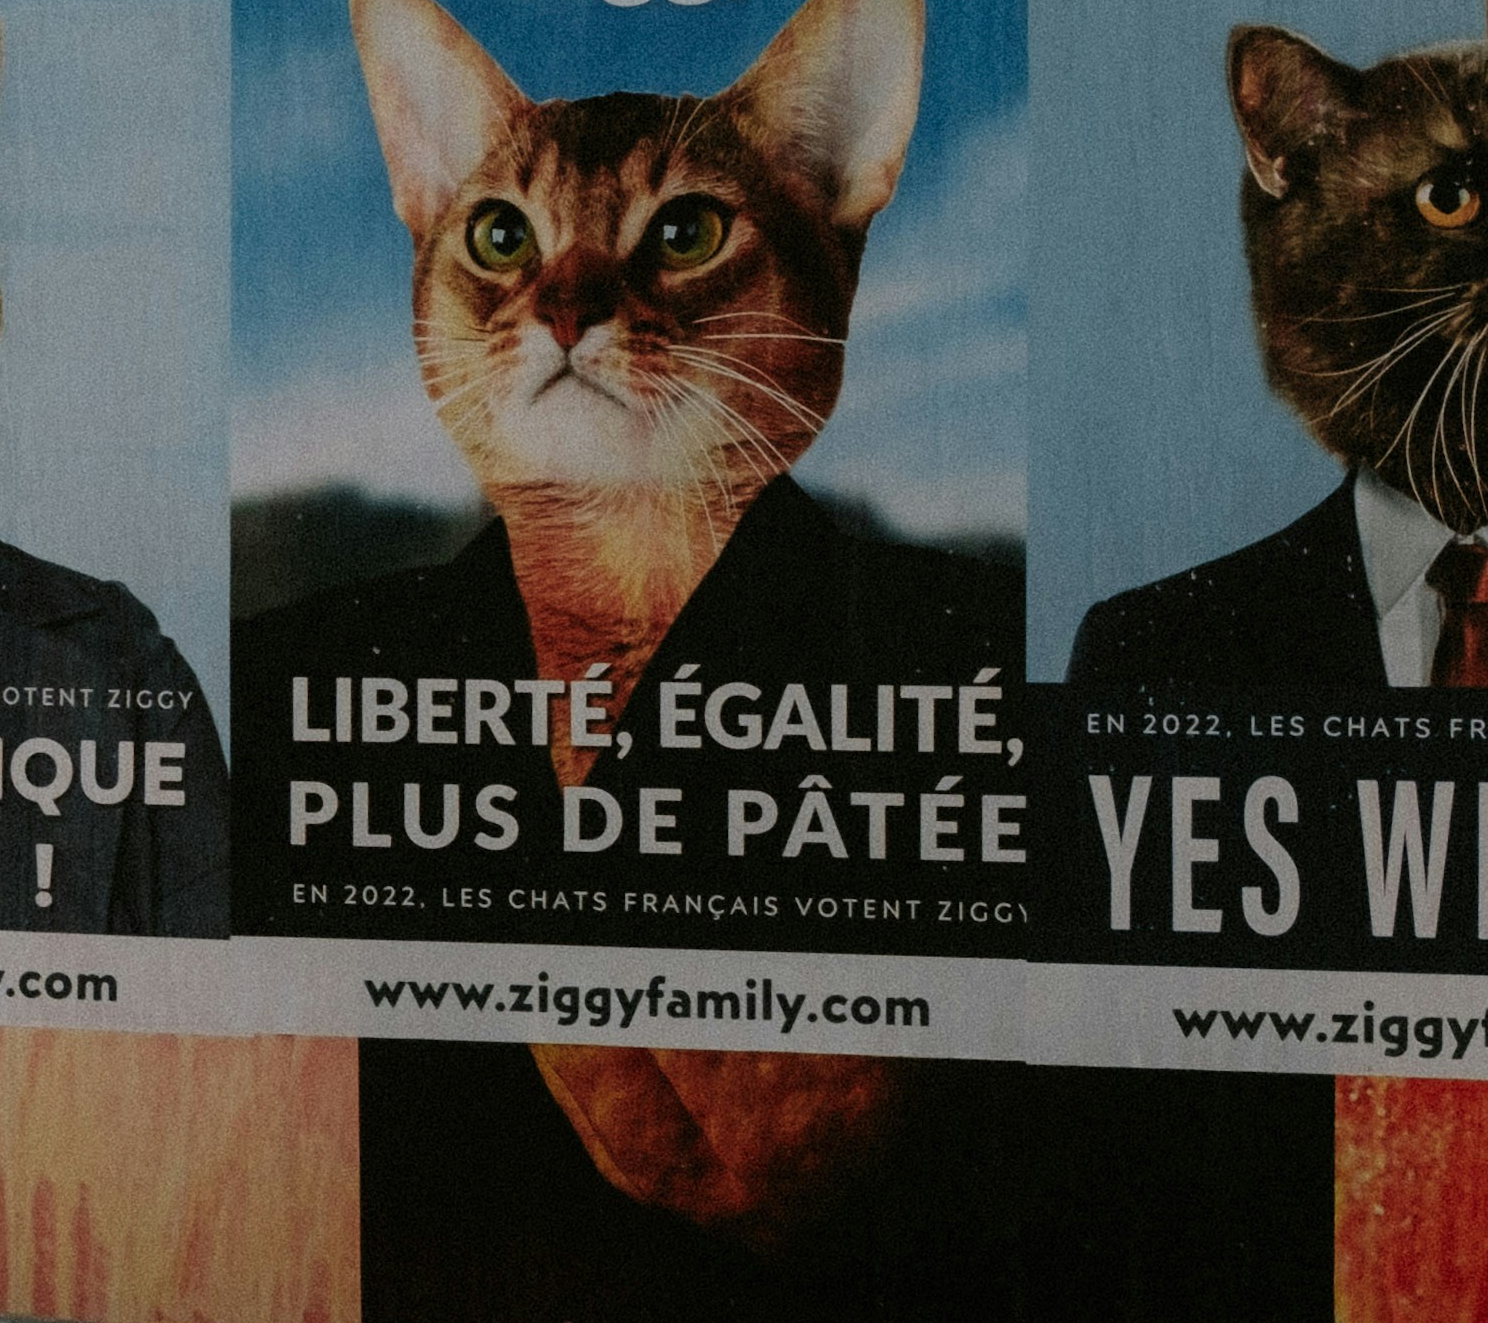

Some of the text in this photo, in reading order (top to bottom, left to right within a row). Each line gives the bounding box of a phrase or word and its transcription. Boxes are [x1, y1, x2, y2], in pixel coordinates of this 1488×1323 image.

[108, 688, 193, 711] ZIGGY
[292, 663, 1025, 766] LIBERTÉ, ÉGALITÉ,
[289, 774, 1027, 863] PLUS DE PÂTÉE
[34, 844, 54, 908] !
[1089, 775, 1301, 936] YES
[292, 884, 328, 904] EN
[344, 885, 425, 908] 2022,
[443, 888, 491, 909] LES
[508, 888, 607, 912] CHATS
[624, 892, 778, 921] FRANÇAIS
[794, 896, 921, 921] VOTENT
[364, 972, 930, 1033] www.ziggyfamily.com
